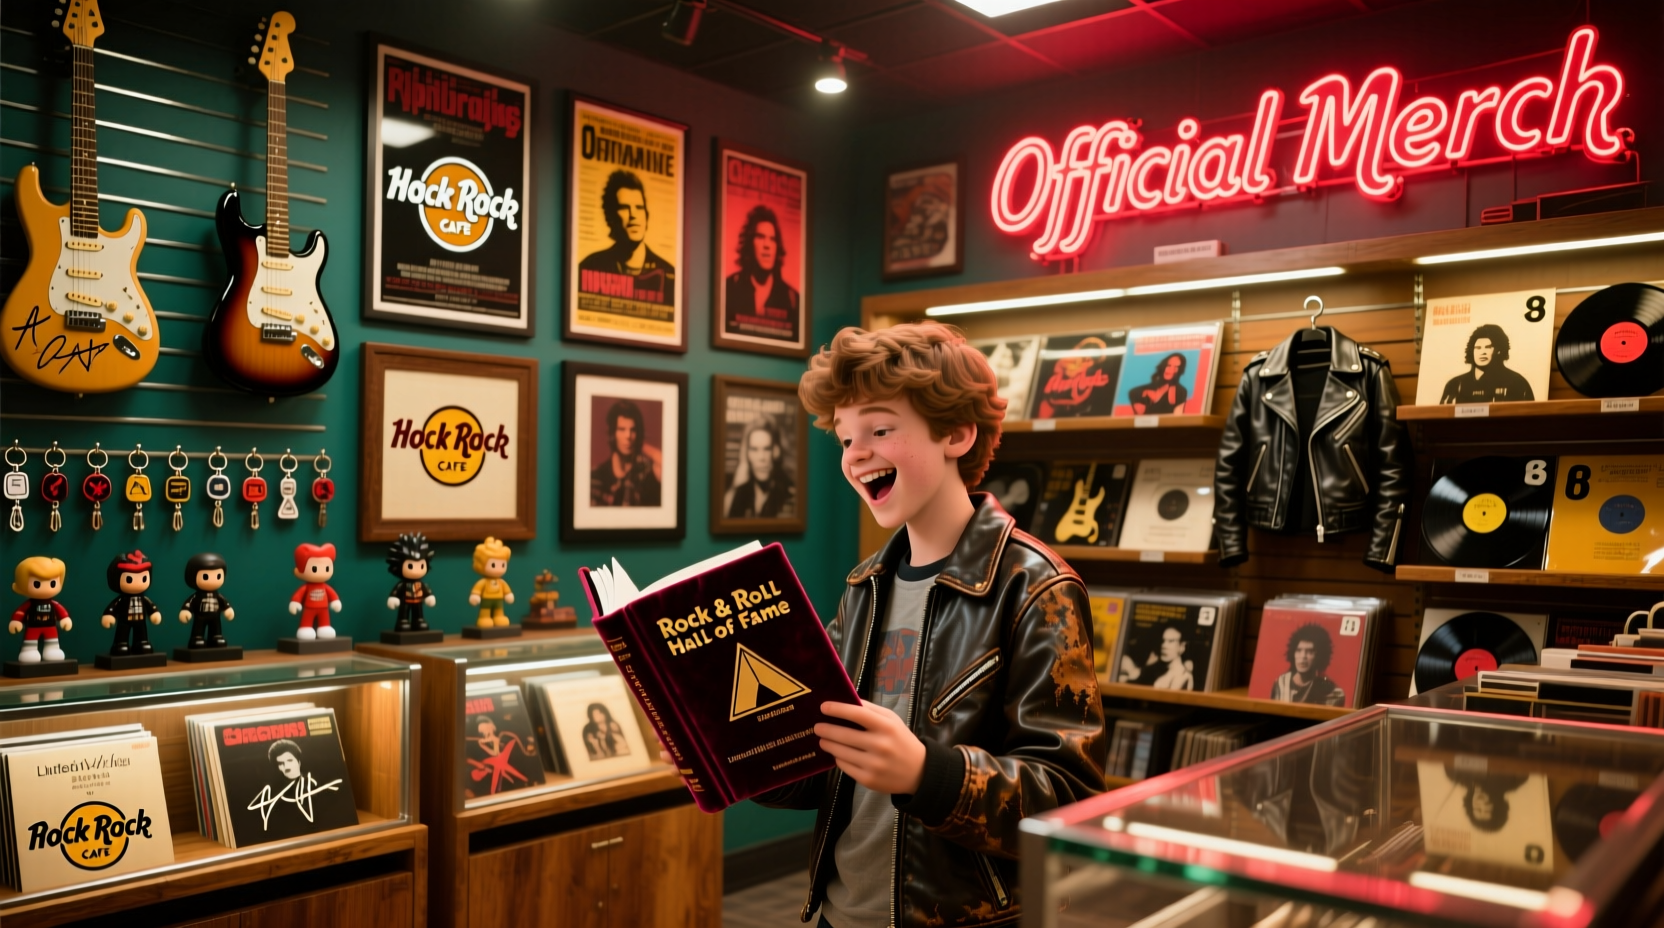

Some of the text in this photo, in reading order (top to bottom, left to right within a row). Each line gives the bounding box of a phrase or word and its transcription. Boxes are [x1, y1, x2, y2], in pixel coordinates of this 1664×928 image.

[991, 27, 1625, 255] Official Merch
[456, 178, 519, 230] Rock
[439, 218, 471, 236] CAFE
[1524, 295, 1546, 322] 8
[391, 418, 509, 459] Hock Rock
[437, 461, 467, 472] CAFE
[656, 605, 713, 639] Rock
[714, 598, 732, 618] &
[714, 618, 734, 639] of
[738, 600, 790, 629] Fame
[93, 808, 153, 845] Rock
[81, 847, 110, 859] CAFE
